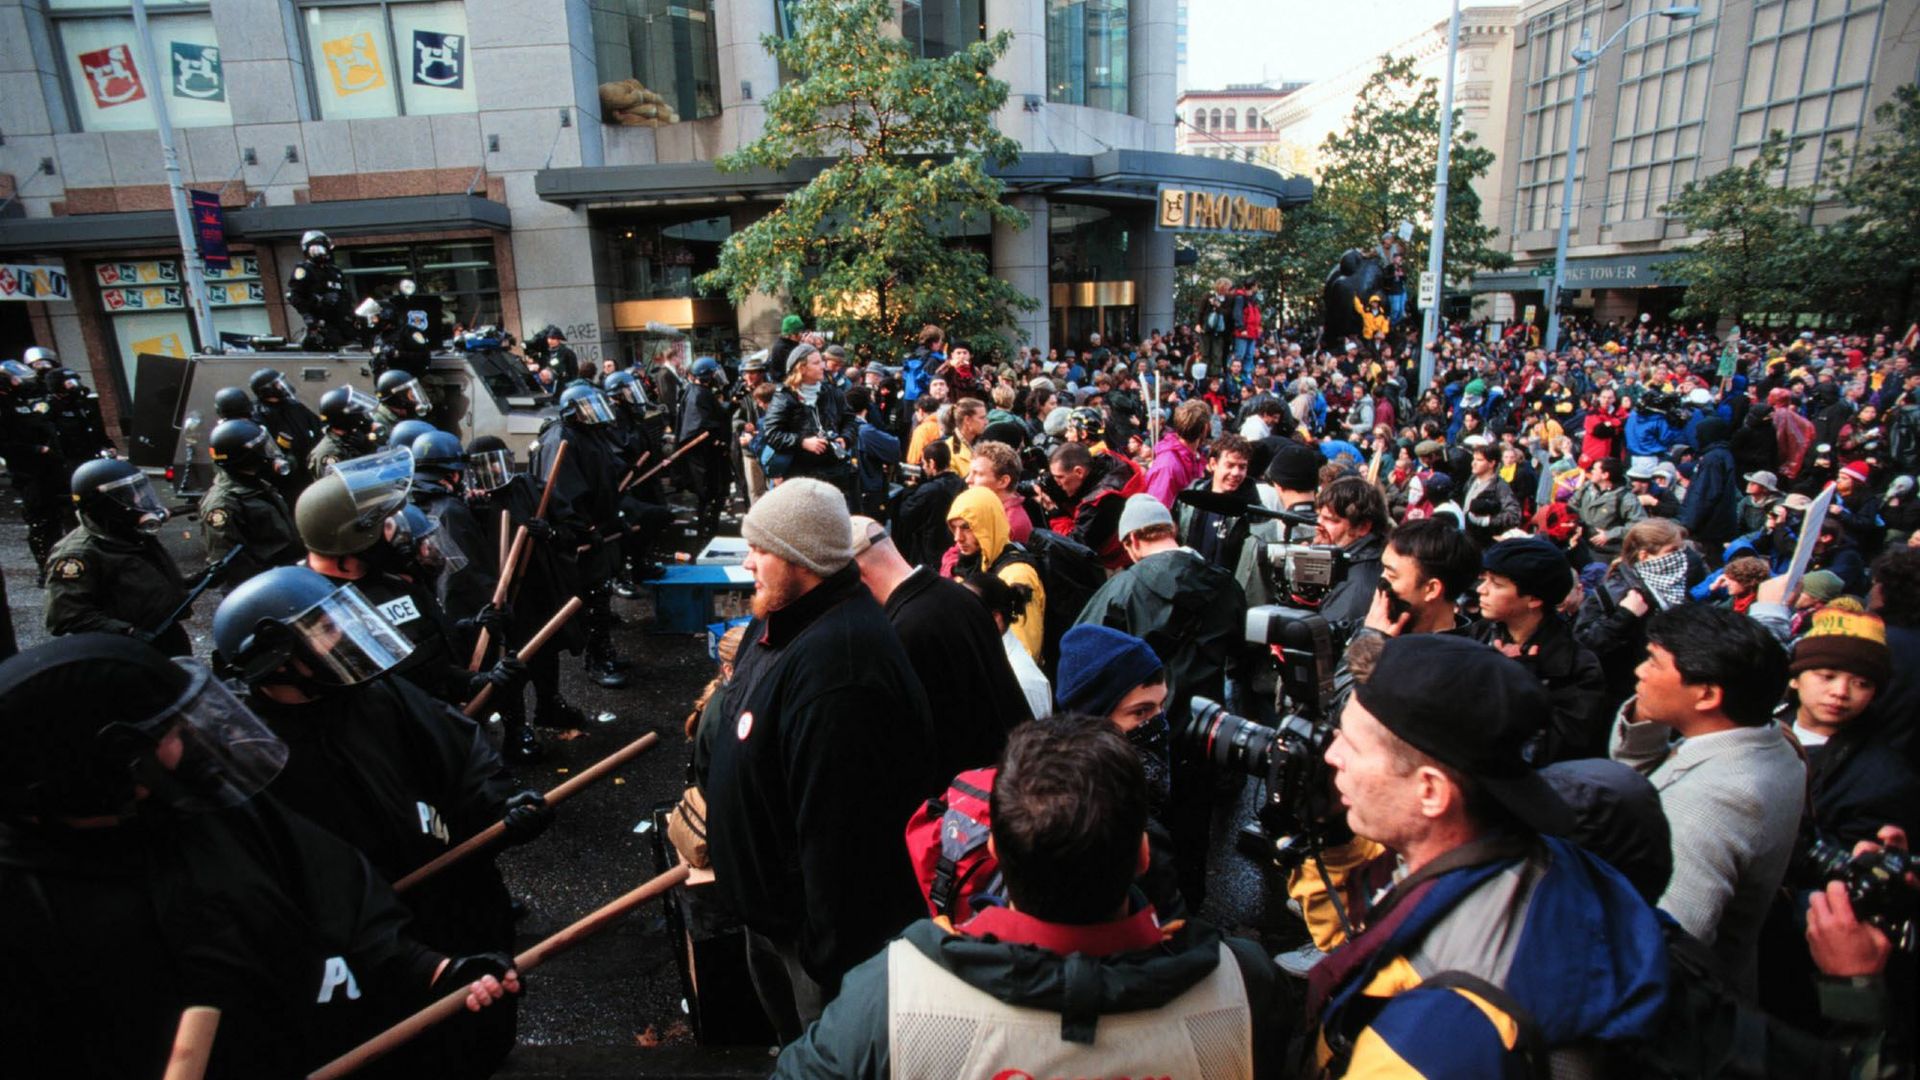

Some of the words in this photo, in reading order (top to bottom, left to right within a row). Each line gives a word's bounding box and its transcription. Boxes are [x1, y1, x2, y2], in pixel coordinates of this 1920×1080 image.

[1189, 192, 1232, 228] FAO
[1422, 275, 1434, 283] ONE
[1590, 265, 1637, 281] TOWER
[566, 323, 597, 340] ARE
[386, 601, 414, 621] ICE
